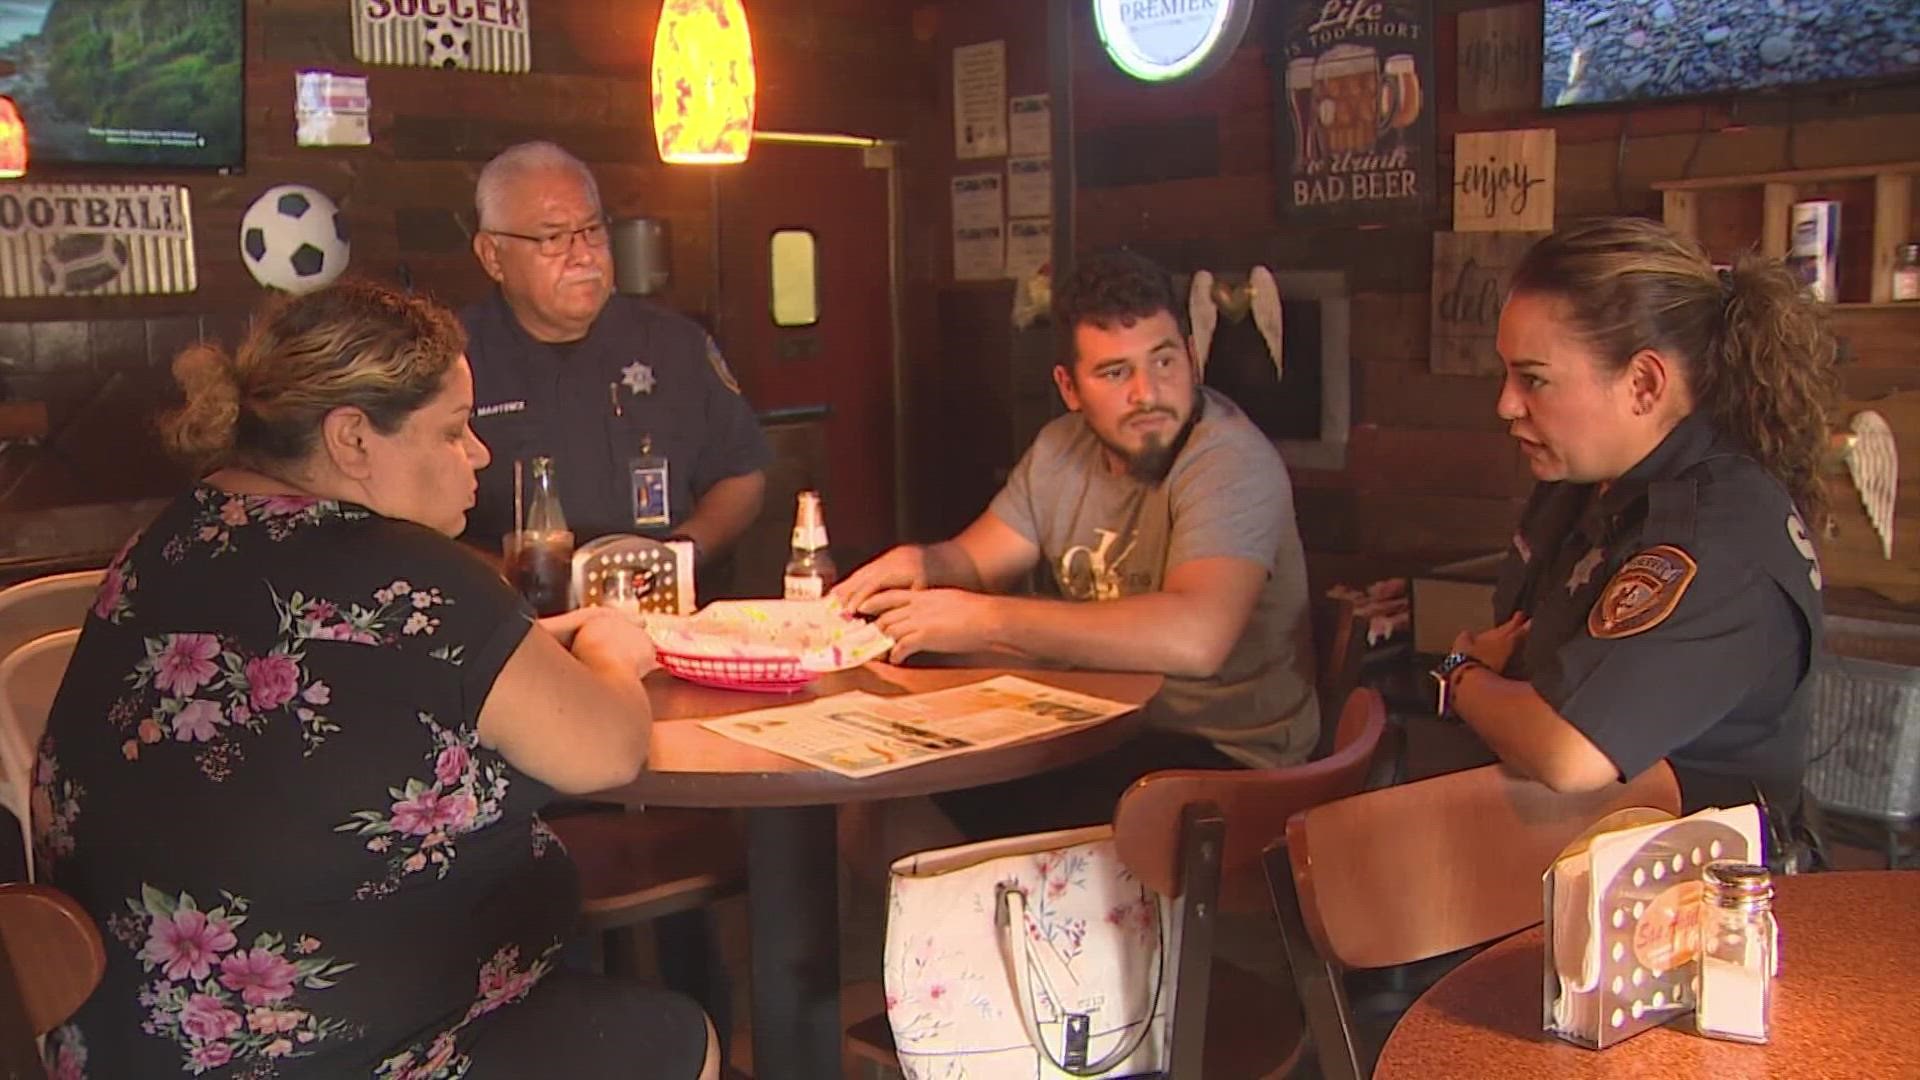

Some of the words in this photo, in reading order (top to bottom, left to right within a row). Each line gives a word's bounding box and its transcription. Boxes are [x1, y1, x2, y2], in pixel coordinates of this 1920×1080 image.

[1308, 0, 1384, 33] Life
[1308, 27, 1346, 48] TOO
[1354, 22, 1420, 40] SHORT
[1293, 175, 1345, 206] BAD
[1351, 169, 1417, 201] BEER
[1455, 156, 1545, 218] enjoy
